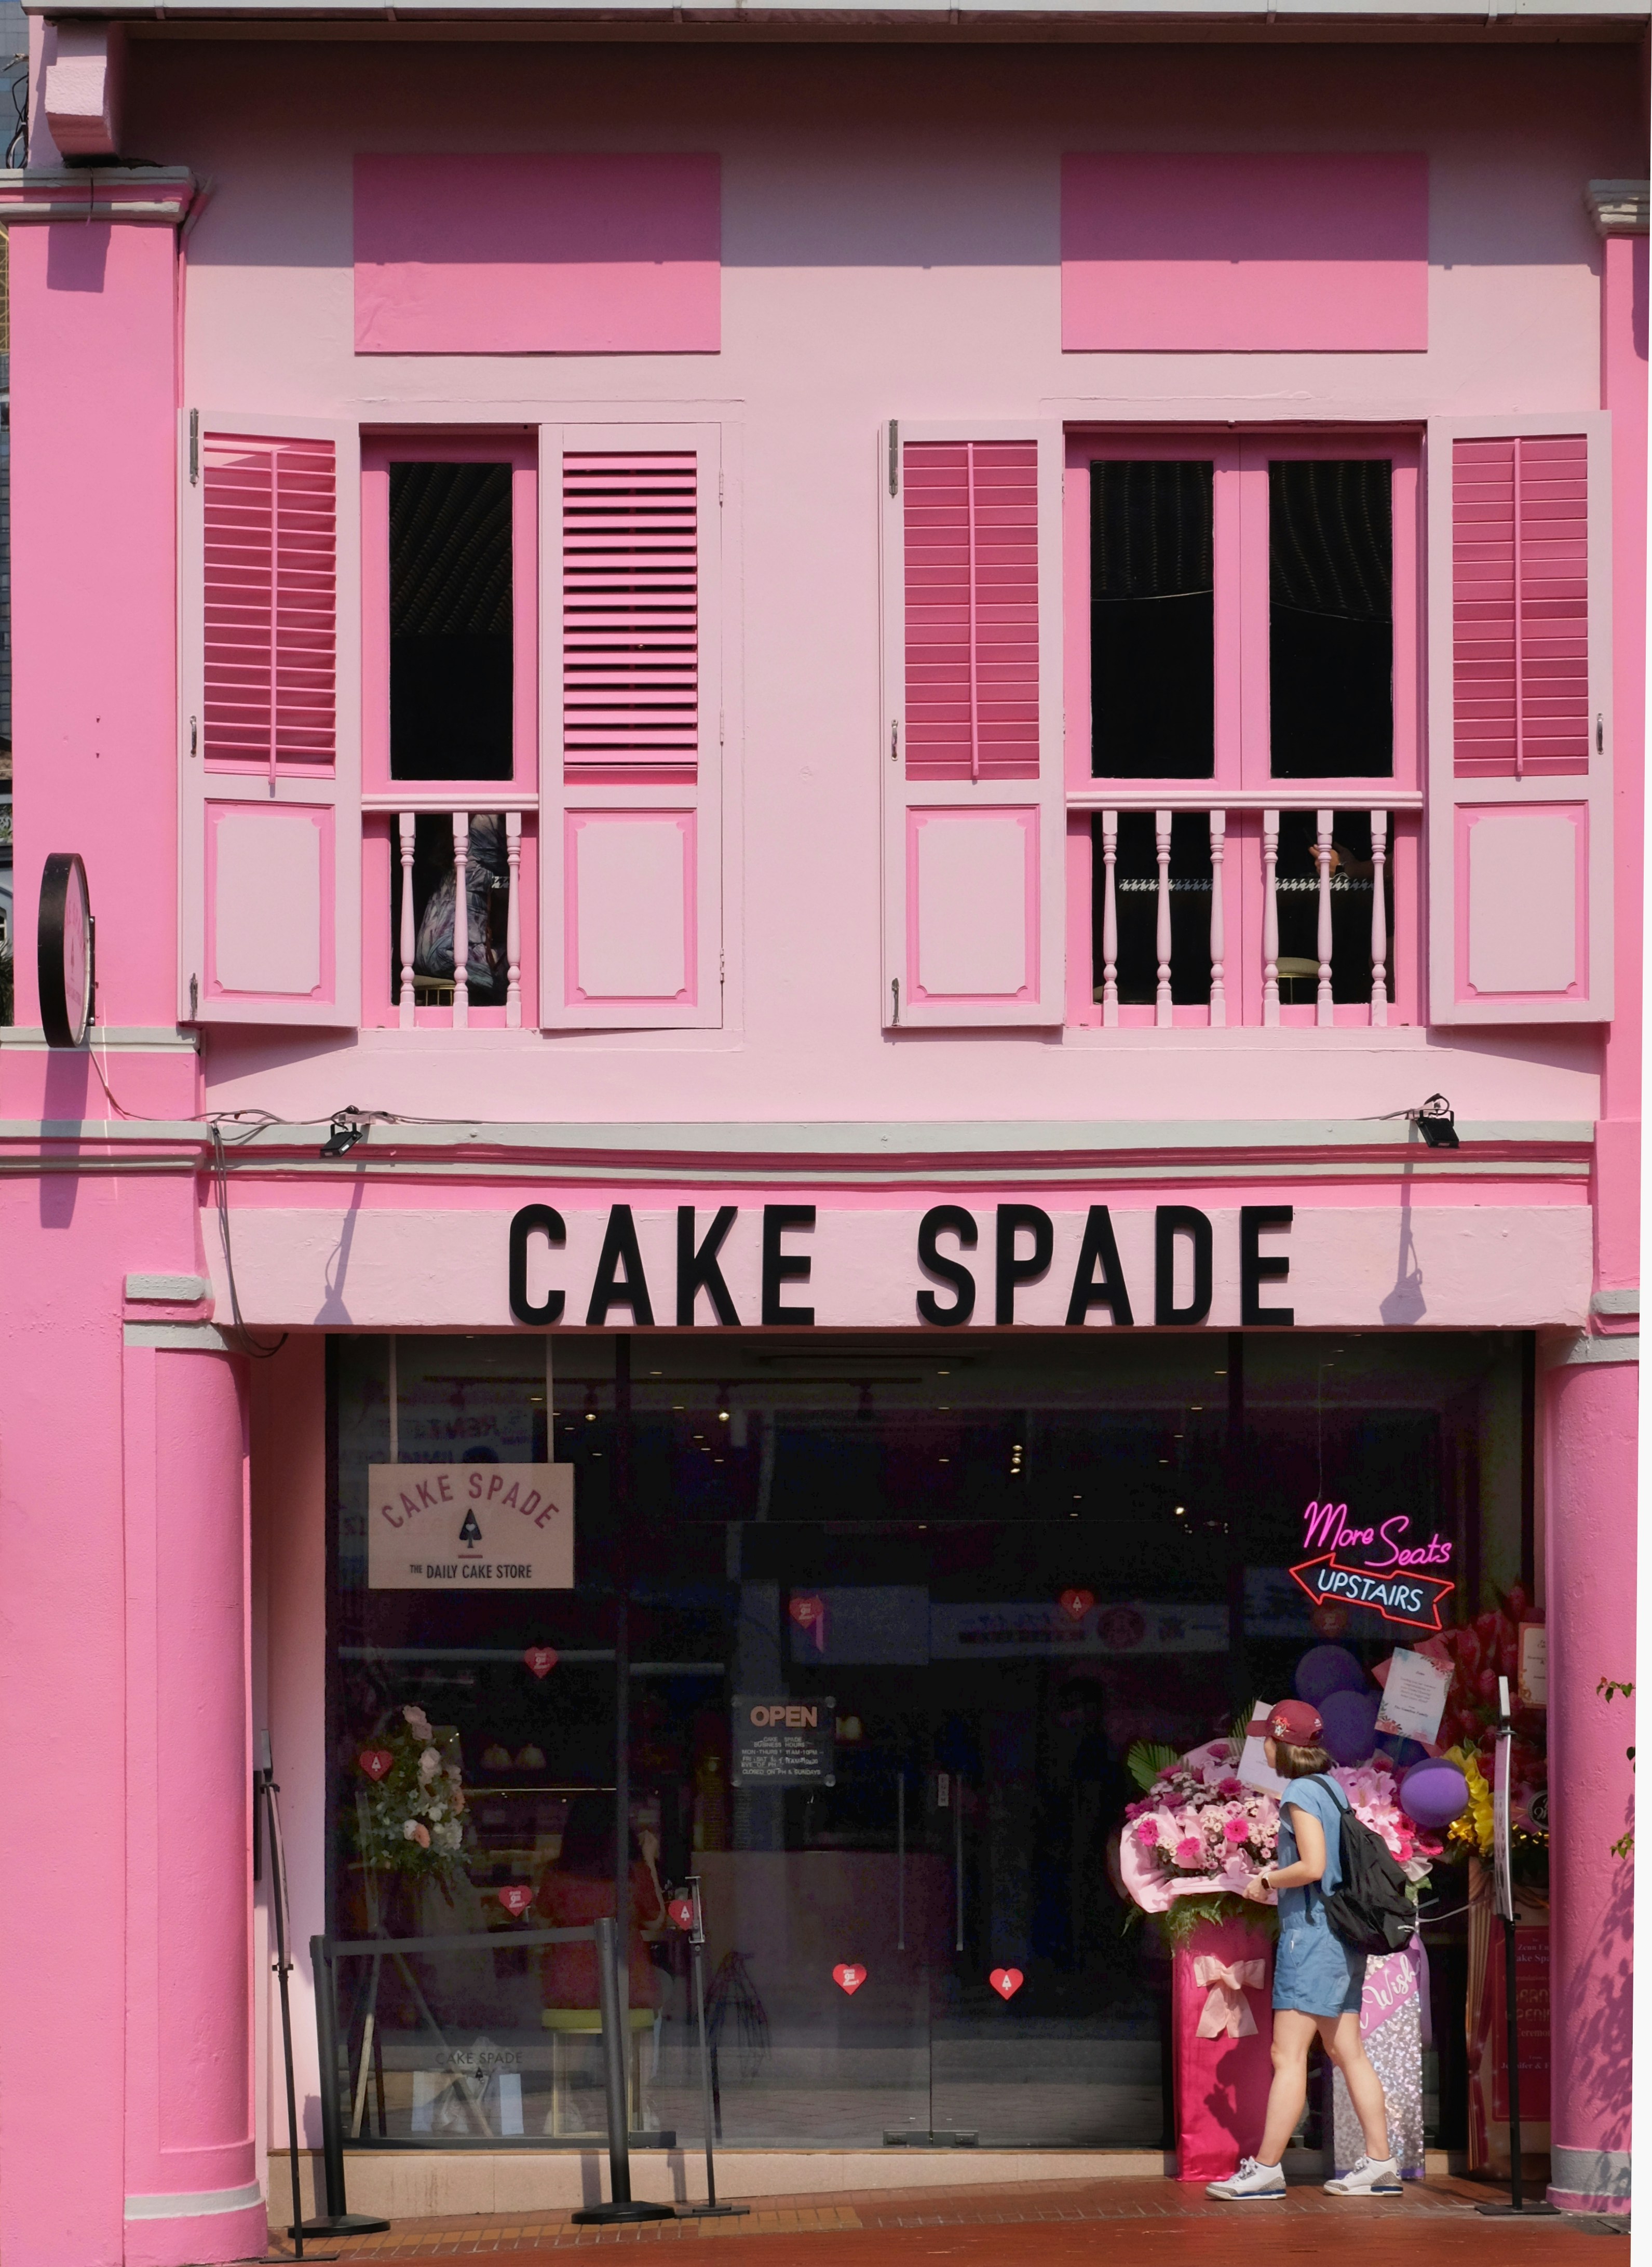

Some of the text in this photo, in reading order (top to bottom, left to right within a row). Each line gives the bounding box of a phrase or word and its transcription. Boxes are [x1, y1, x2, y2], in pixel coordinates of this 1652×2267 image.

[509, 1204, 1294, 1327] CAKE SPADE
[381, 1472, 560, 1529] CAKE SPADE
[1304, 1501, 1452, 1567] More Seats
[410, 1564, 532, 1578] THE DAILY CAKE STORE
[1317, 1569, 1424, 1612] UPSTAIRS
[750, 1705, 818, 1728] OPEN
[1516, 1989, 1550, 2003] RAN
[435, 2052, 523, 2064] CAKE SPADE
